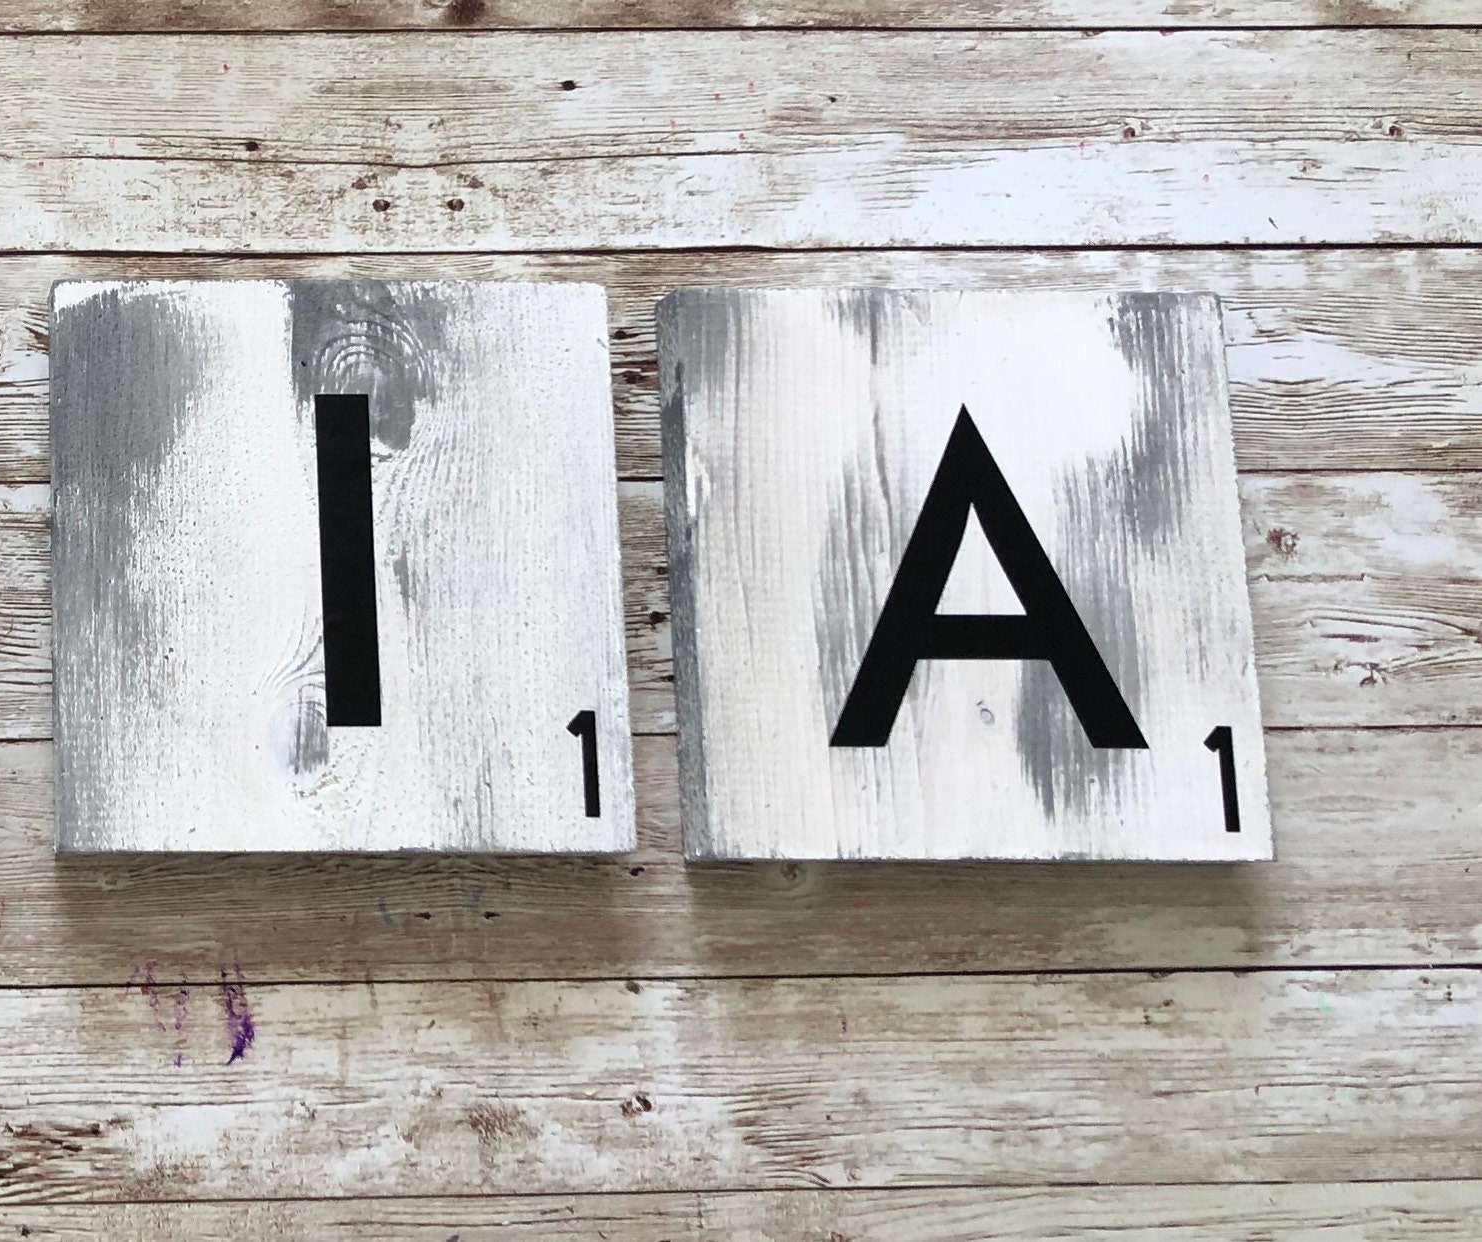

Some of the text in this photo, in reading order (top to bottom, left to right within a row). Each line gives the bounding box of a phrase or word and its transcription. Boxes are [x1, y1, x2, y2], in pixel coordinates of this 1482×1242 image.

[314, 393, 382, 727] I
[829, 404, 1150, 749] A
[567, 710, 601, 818] 1
[1204, 726, 1240, 833] 1
